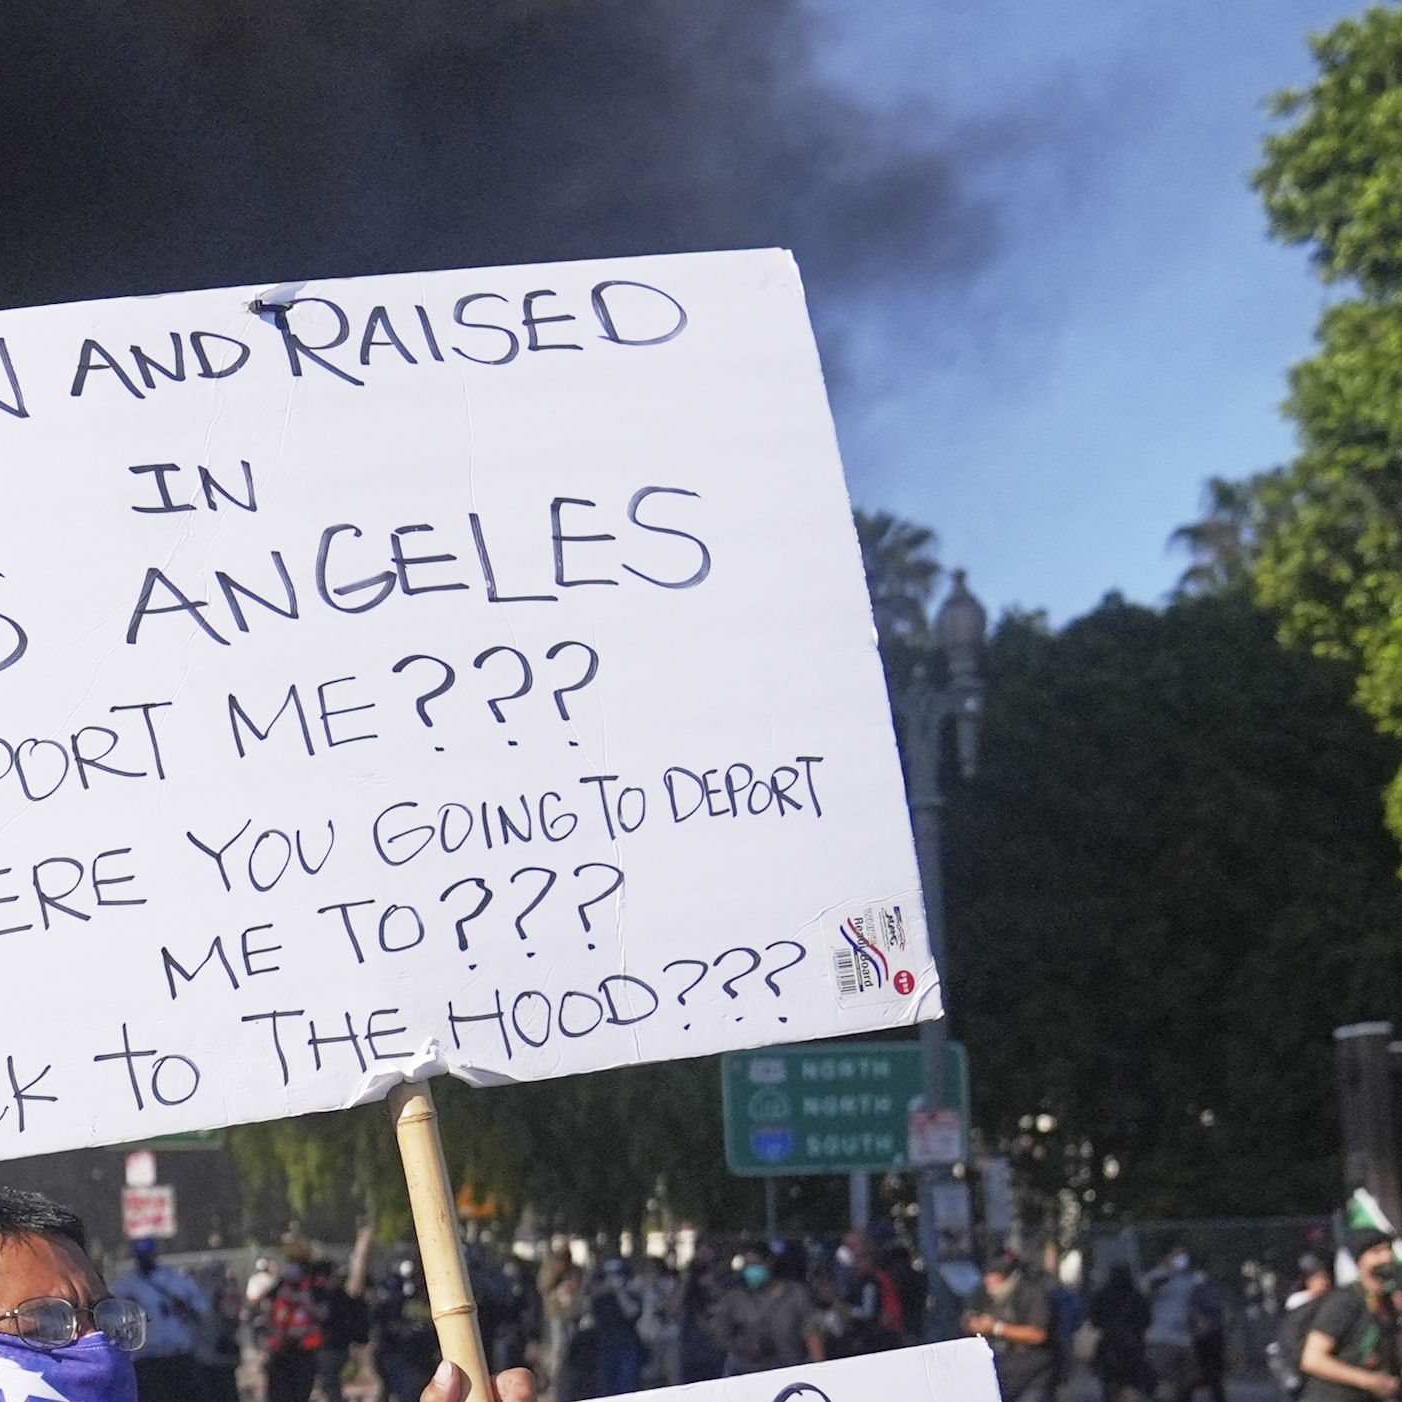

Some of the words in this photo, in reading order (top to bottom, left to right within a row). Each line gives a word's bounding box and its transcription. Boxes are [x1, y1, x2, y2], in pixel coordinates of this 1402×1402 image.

[69, 331, 251, 400] AND
[272, 280, 688, 386] RAISED
[128, 460, 258, 513] IN
[126, 486, 712, 645] ANGELES
[187, 818, 335, 892] YOU
[373, 792, 578, 866] GOING
[580, 775, 646, 840] TO
[663, 756, 824, 822] DEPORT
[161, 922, 283, 1000] ME
[241, 1008, 415, 1086] THE
[448, 939, 806, 1060] HOOD???
[802, 1058, 892, 1080] NORTH
[802, 1094, 893, 1117] NORTH
